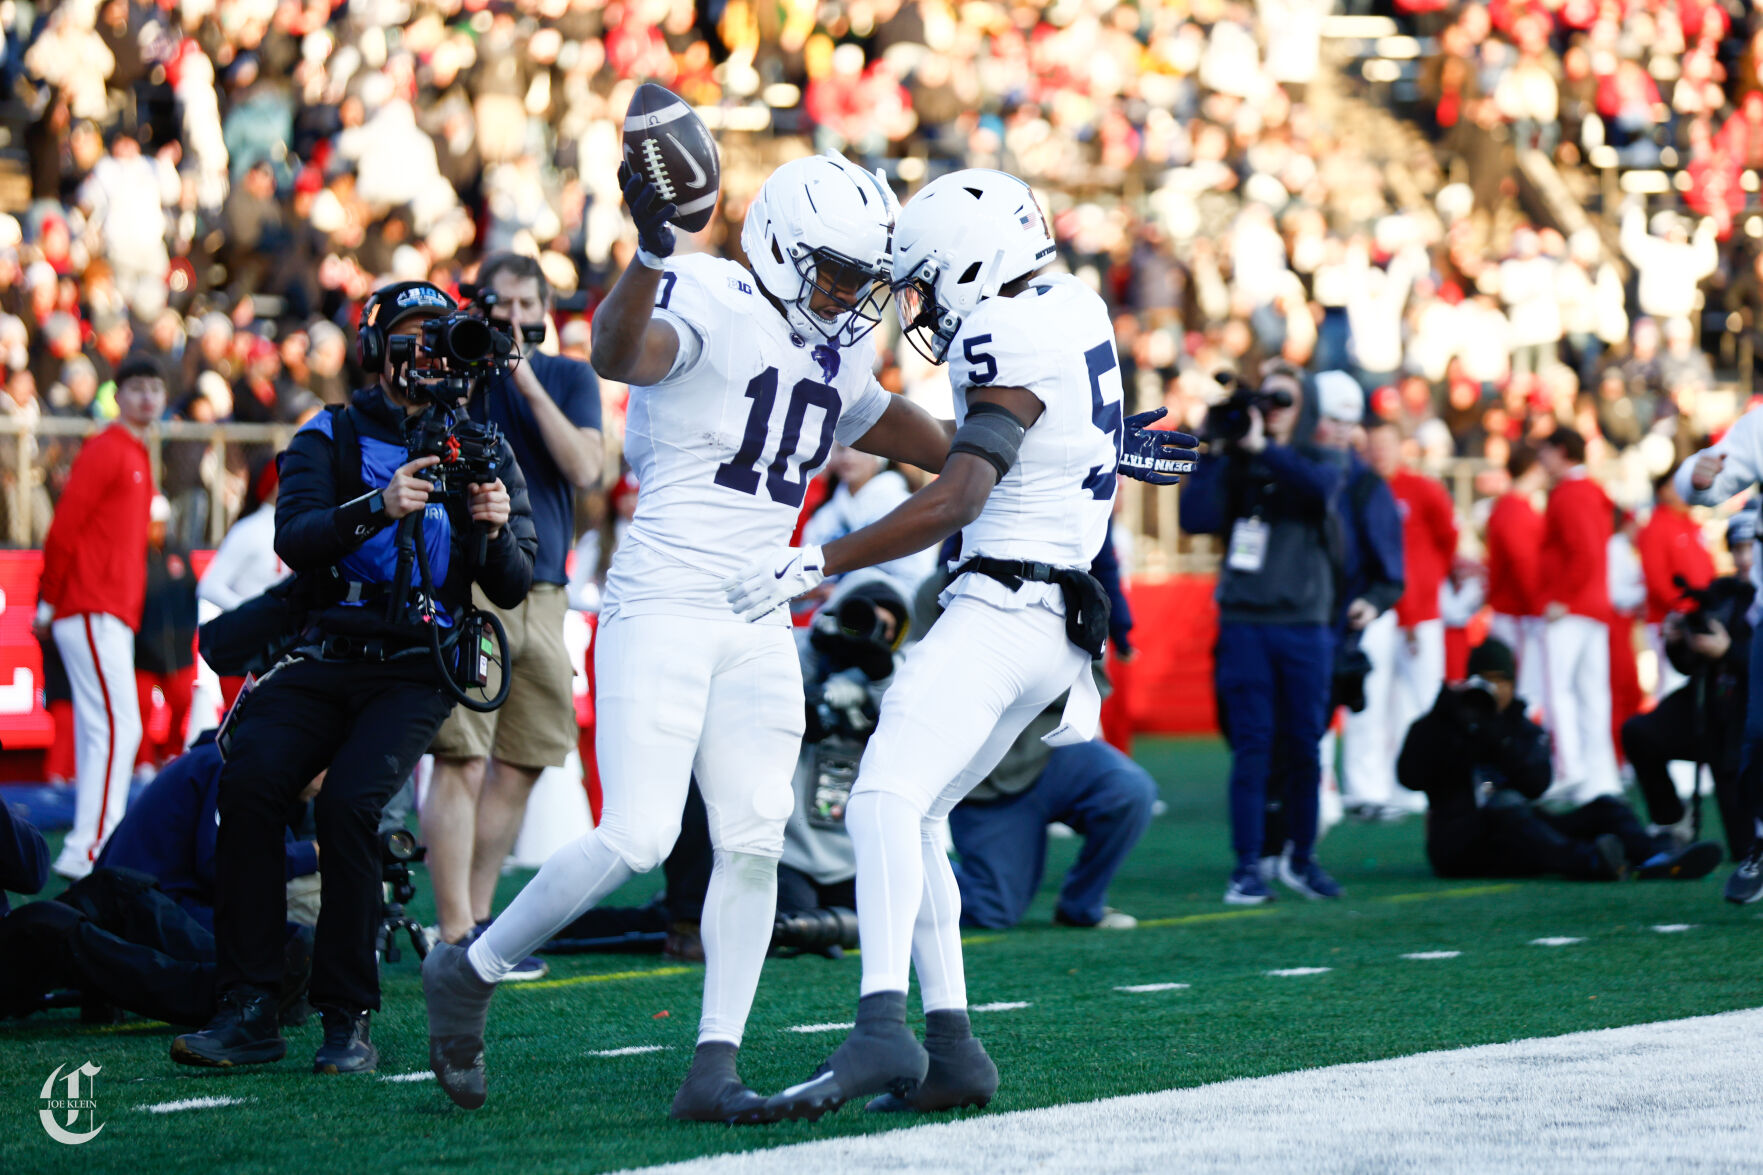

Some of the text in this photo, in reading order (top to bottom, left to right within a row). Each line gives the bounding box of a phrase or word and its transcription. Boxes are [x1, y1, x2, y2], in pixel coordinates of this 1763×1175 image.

[963, 333, 998, 384] 5
[713, 365, 842, 508] 10
[1082, 339, 1122, 501] 5
[1120, 453, 1193, 472] PENN STAT
